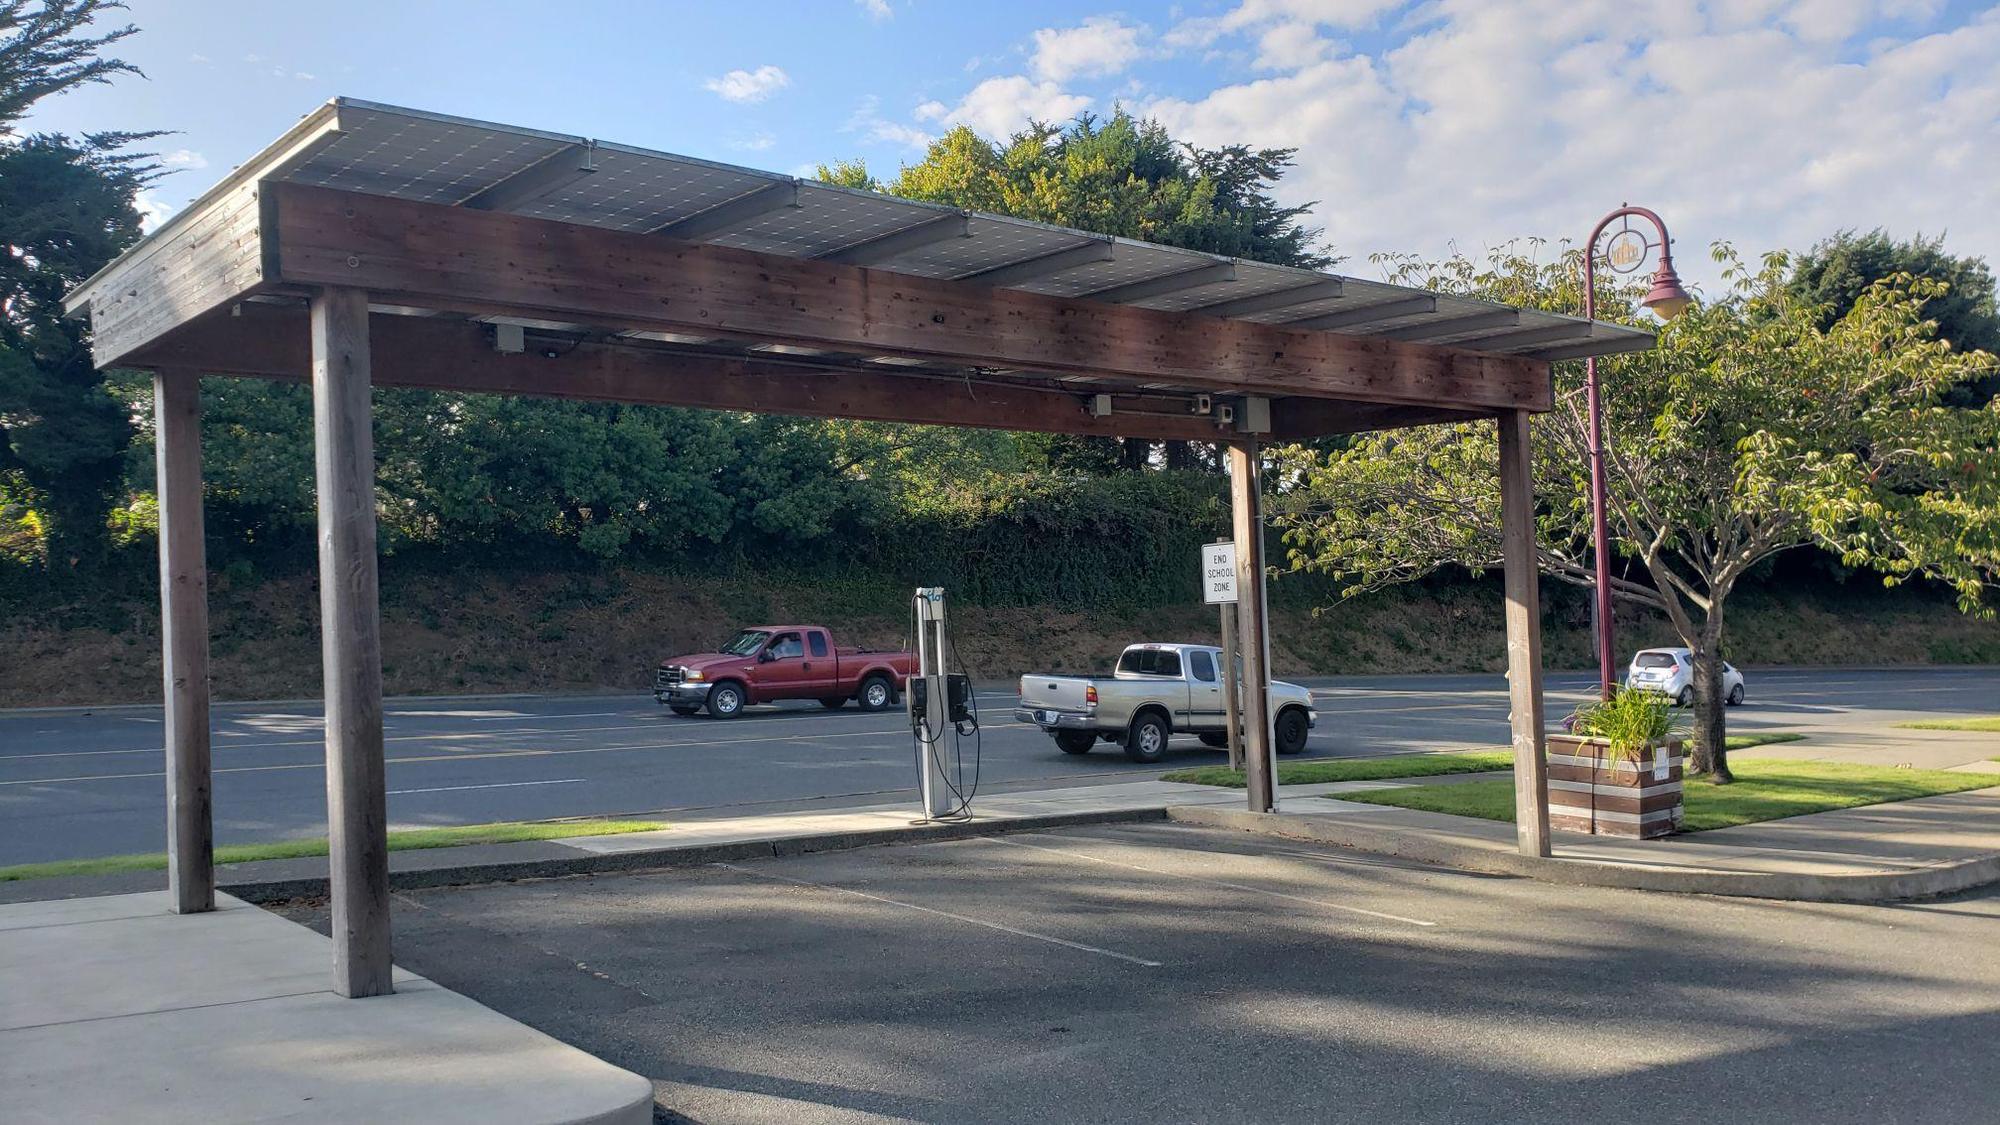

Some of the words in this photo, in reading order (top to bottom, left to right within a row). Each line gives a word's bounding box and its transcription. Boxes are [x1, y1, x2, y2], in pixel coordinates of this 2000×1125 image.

[1213, 555, 1227, 564] END
[1207, 568, 1234, 578] SCHOOL
[1213, 582, 1230, 592] ZONE
